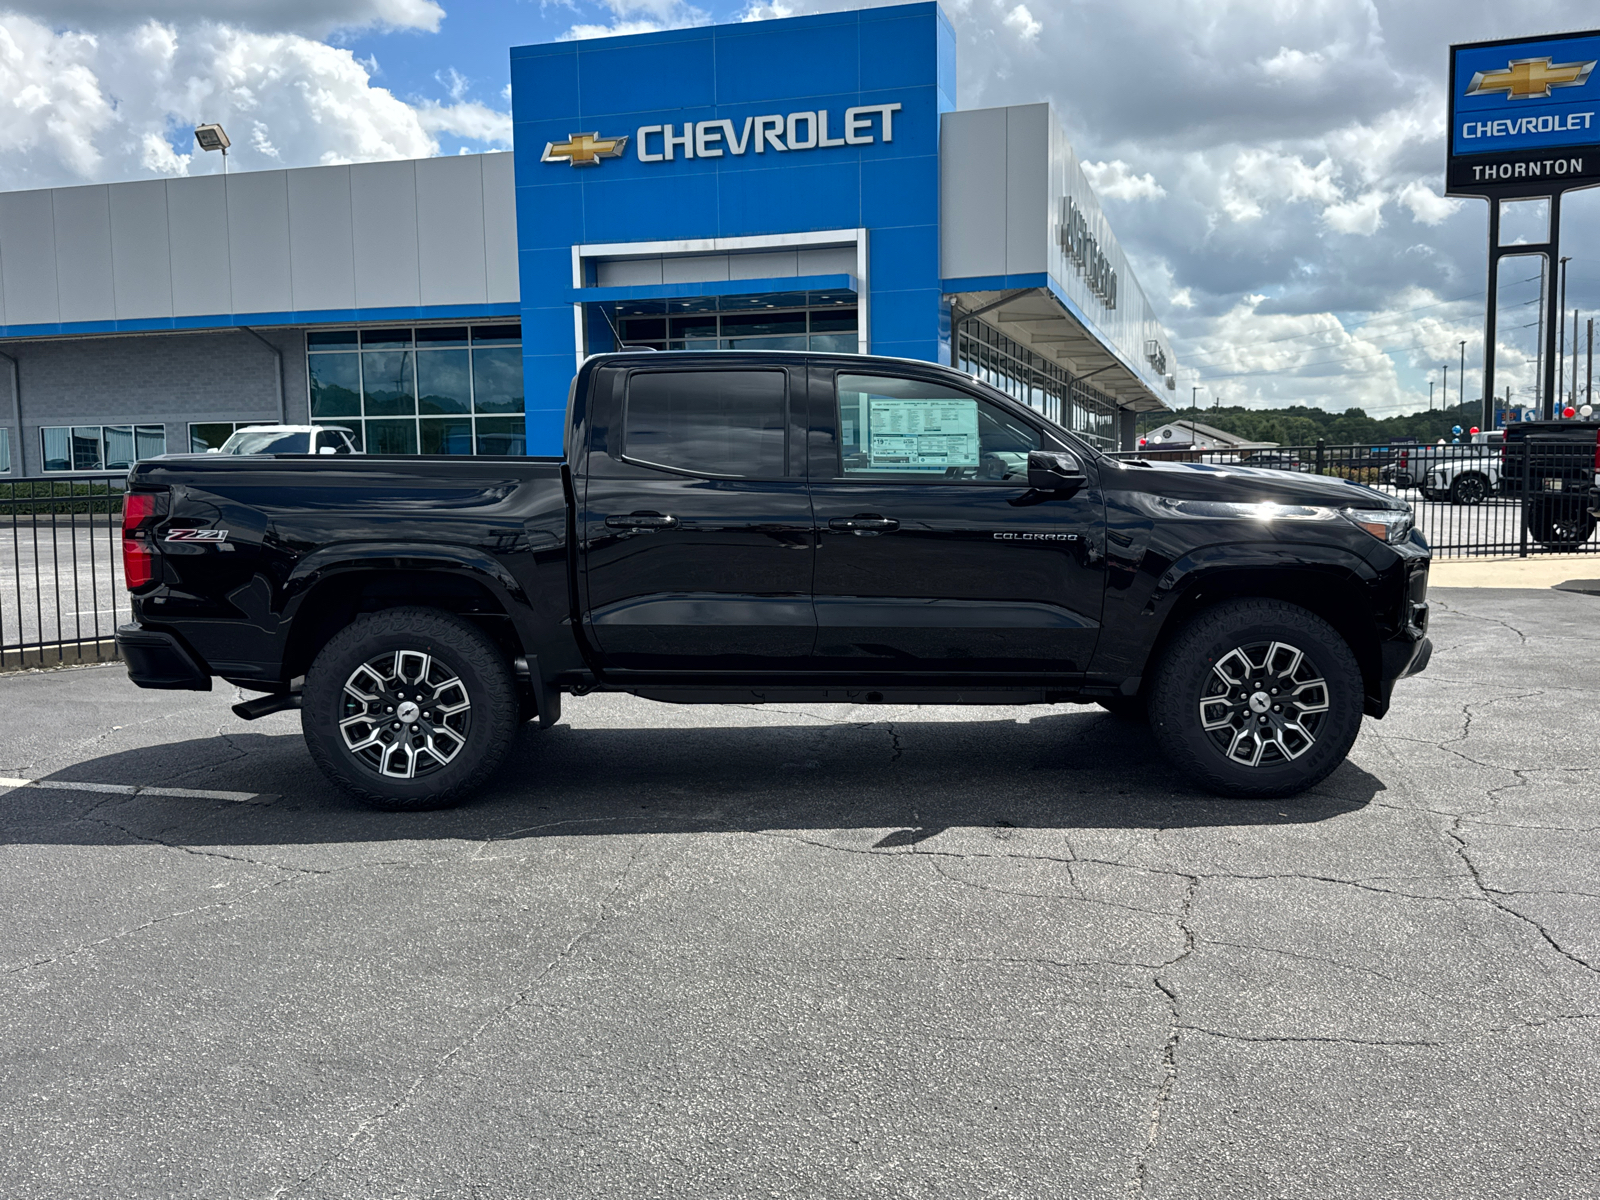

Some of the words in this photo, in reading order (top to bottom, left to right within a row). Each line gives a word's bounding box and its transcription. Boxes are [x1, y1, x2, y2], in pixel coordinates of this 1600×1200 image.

[636, 102, 902, 163] CHEVROLET
[1462, 112, 1595, 139] CHEVROLET
[1472, 158, 1583, 180] THORNTON
[164, 529, 229, 543] Z71
[993, 532, 1078, 541] COLORADO
[320, 643, 368, 726] WRANGLER
[1184, 641, 1224, 730] WRANGLER
